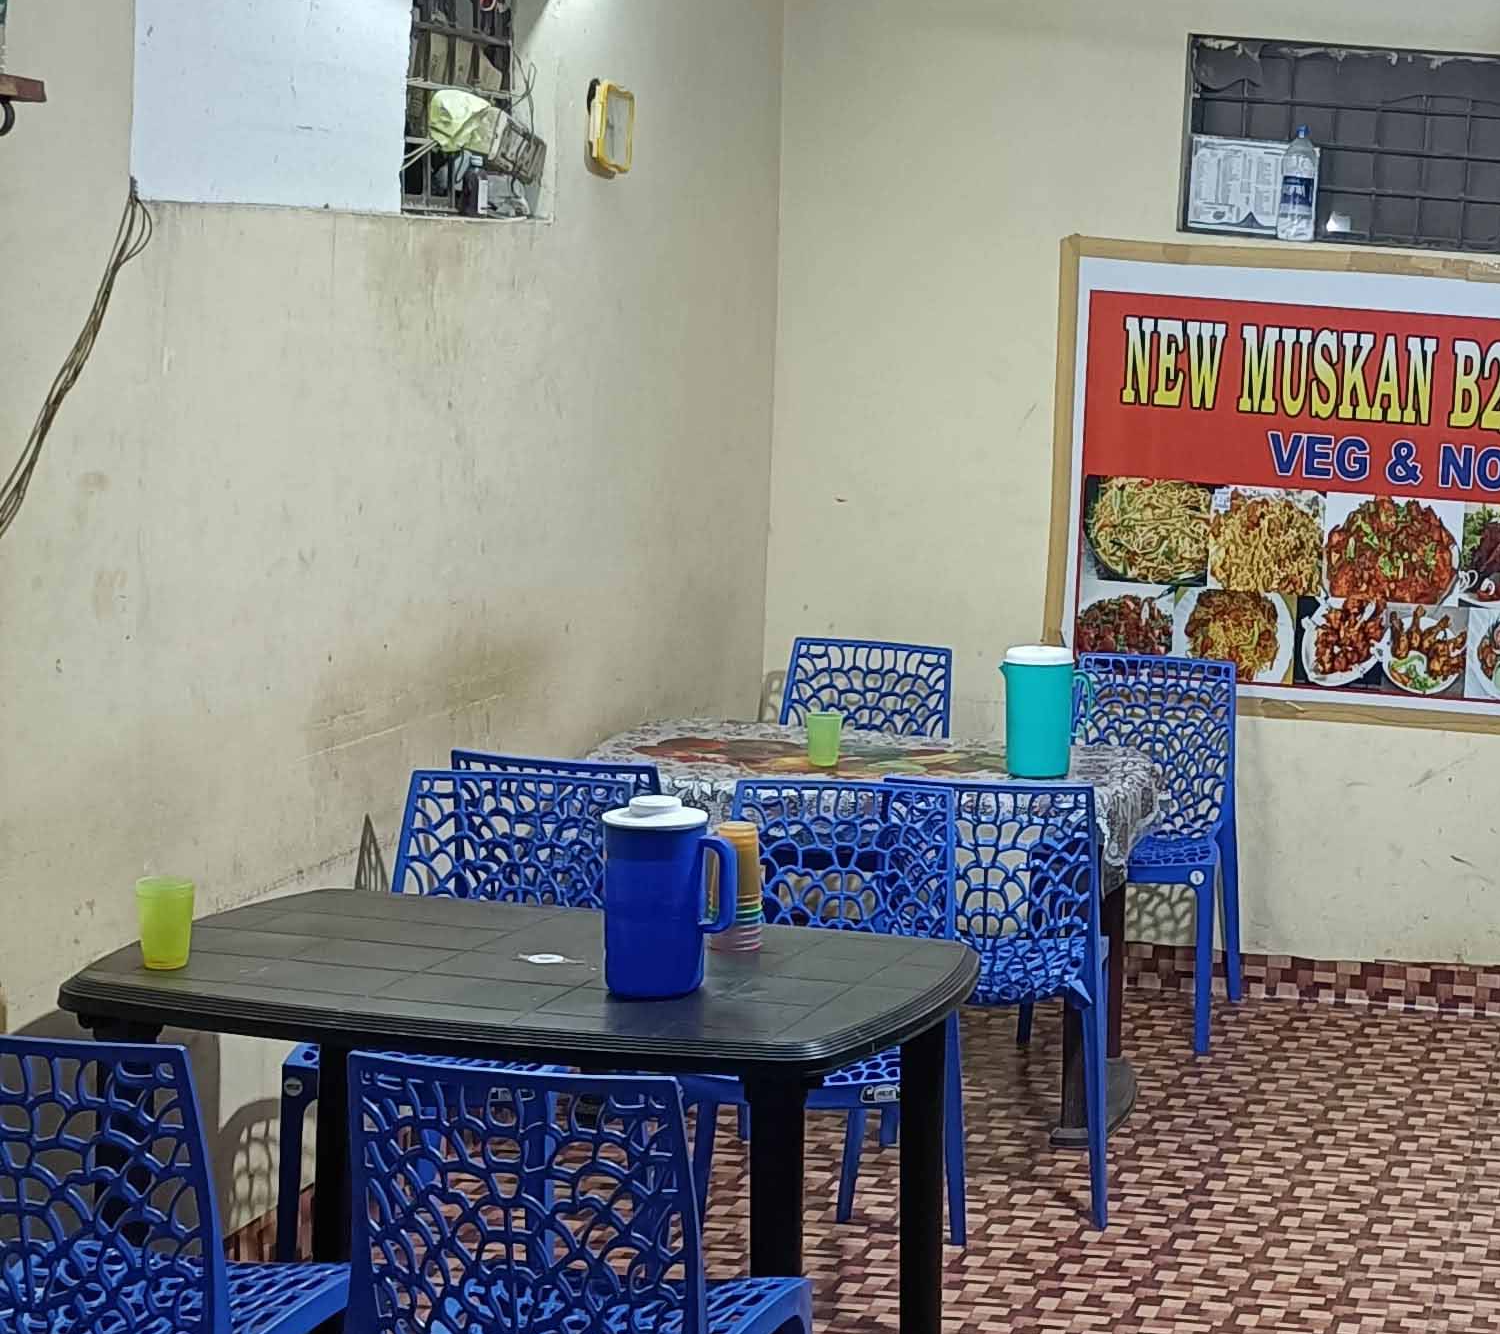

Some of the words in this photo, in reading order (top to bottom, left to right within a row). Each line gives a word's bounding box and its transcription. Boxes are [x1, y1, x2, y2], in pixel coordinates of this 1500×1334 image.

[1122, 315, 1227, 410] NEW
[1238, 323, 1438, 426] MUSKAN
[1267, 431, 1372, 480] VEG
[1387, 438, 1422, 485] &
